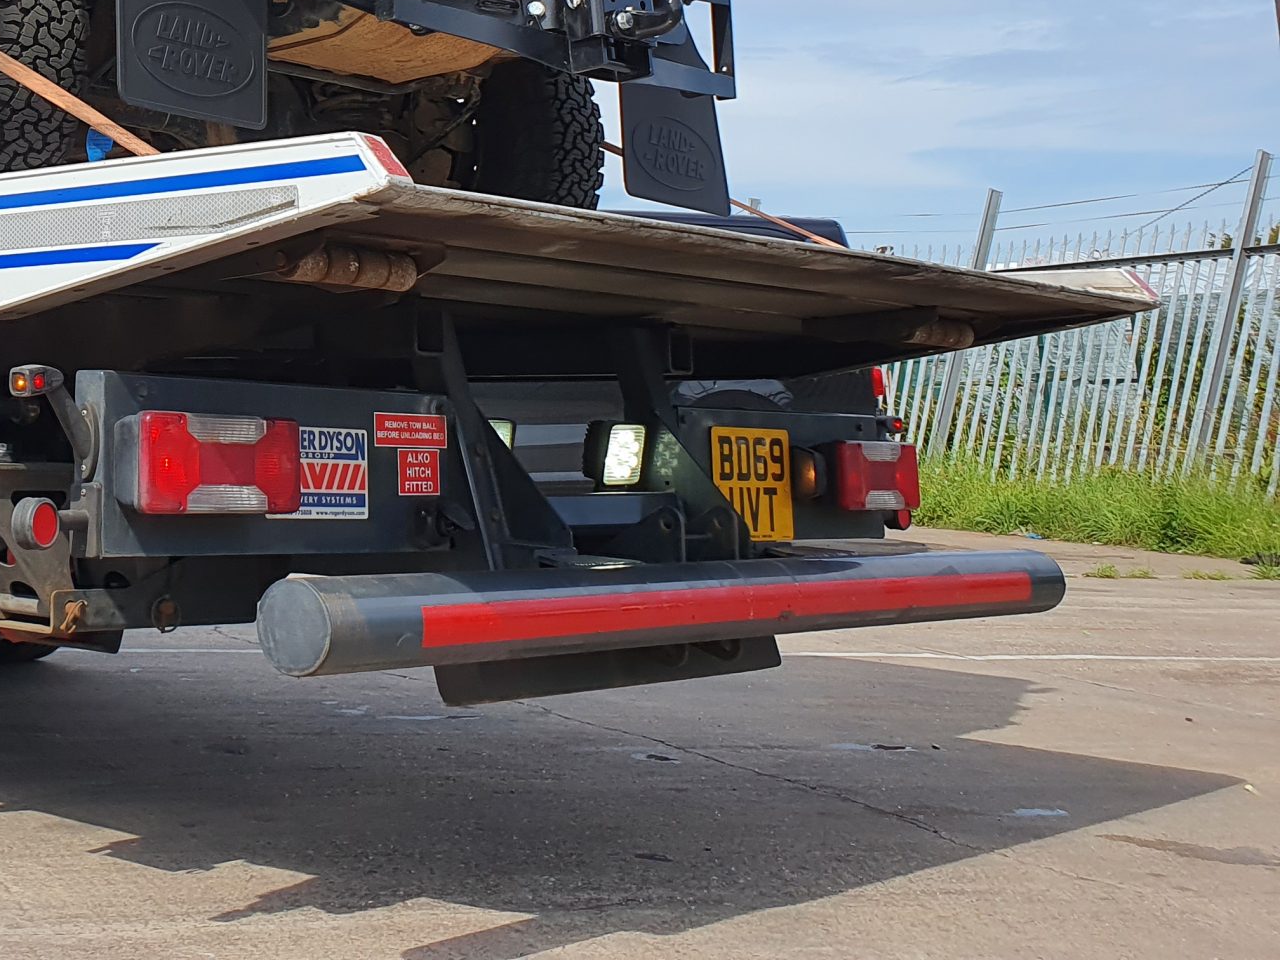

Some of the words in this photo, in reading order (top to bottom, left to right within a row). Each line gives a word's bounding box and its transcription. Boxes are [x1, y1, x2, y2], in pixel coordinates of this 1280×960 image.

[156, 13, 215, 48] LAND
[161, 45, 239, 83] ROVER
[648, 123, 688, 153] LAND
[654, 147, 705, 181] ROVER
[377, 430, 400, 438] BEFORE
[400, 431, 432, 440] UNLOADING
[432, 432, 445, 440] BED
[384, 420, 409, 429] REMOVE
[409, 421, 422, 429] TOW
[422, 422, 437, 430] BALL
[319, 430, 366, 461] DYSON
[406, 452, 431, 464] ALKO
[717, 435, 785, 482] BD69
[406, 467, 432, 478] HITCH
[405, 481, 434, 492] FITTED
[321, 495, 357, 504] SYSTEMS
